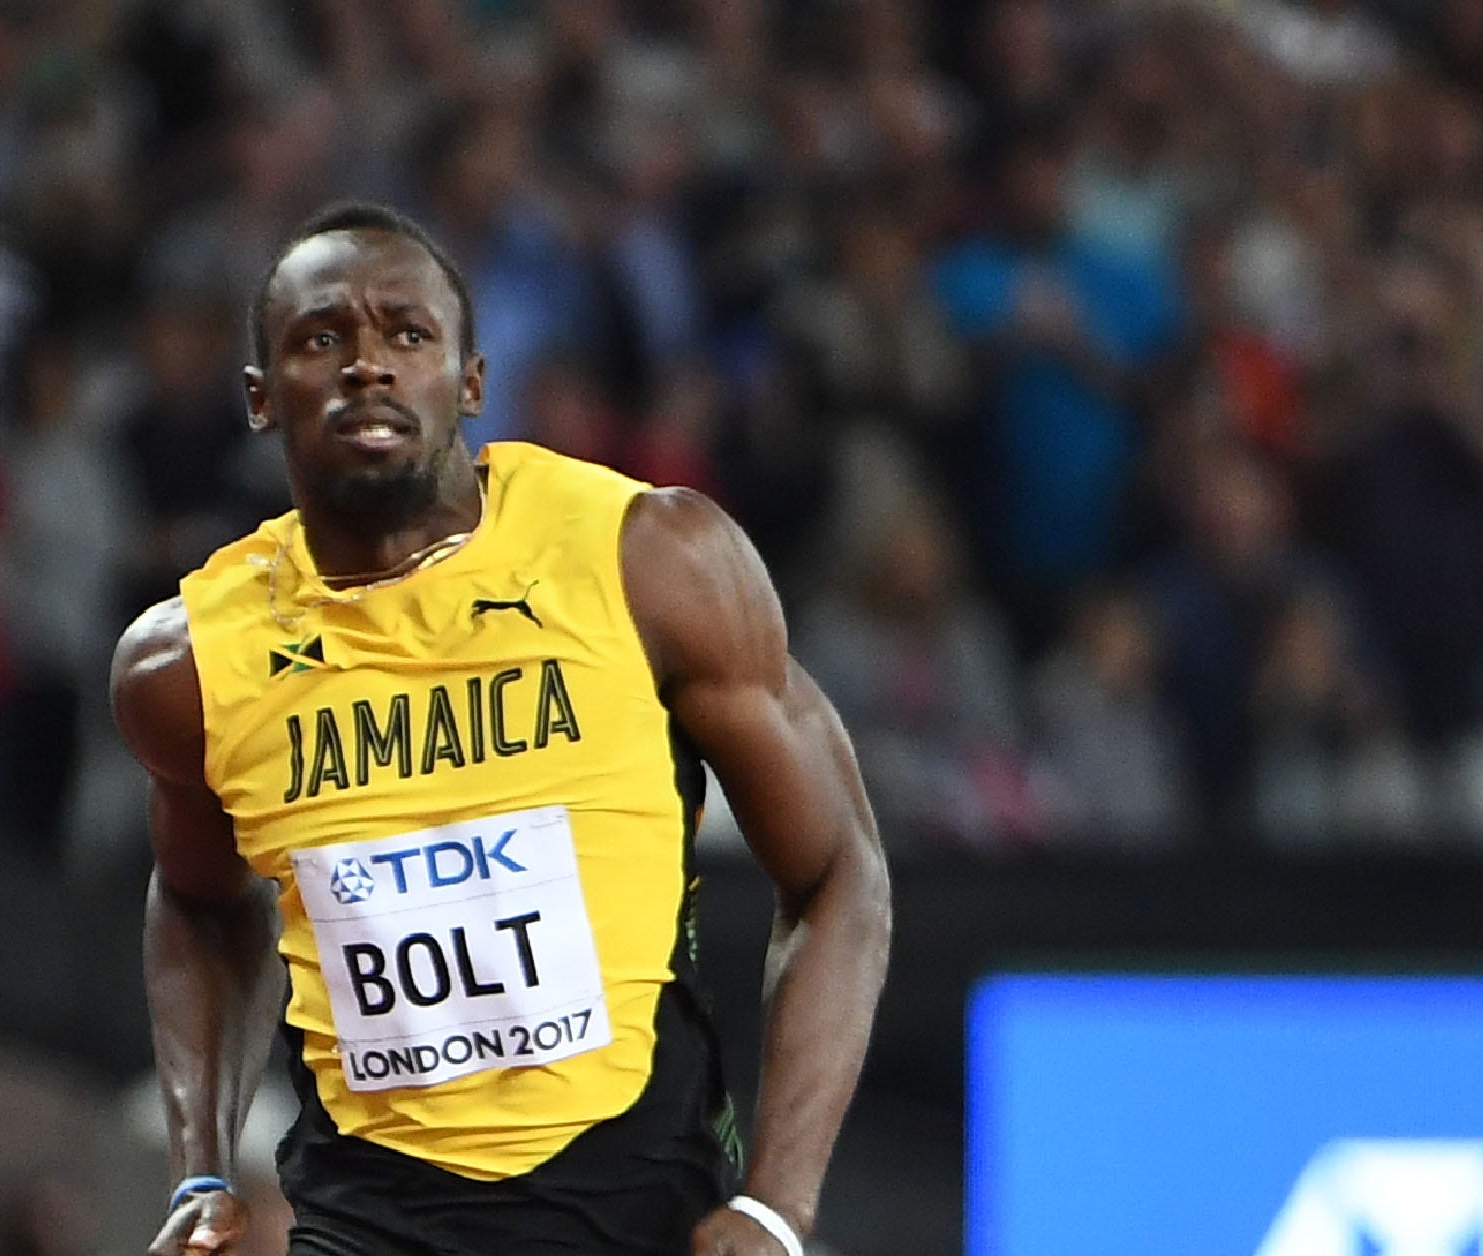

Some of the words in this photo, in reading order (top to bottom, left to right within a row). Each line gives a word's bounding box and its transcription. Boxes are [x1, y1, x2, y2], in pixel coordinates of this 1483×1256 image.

[283, 658, 581, 803] JAMAICA
[371, 828, 528, 895] TDK
[342, 910, 542, 1018] BOLT
[349, 1026, 505, 1081] LONDON
[508, 1009, 593, 1056] 2017
